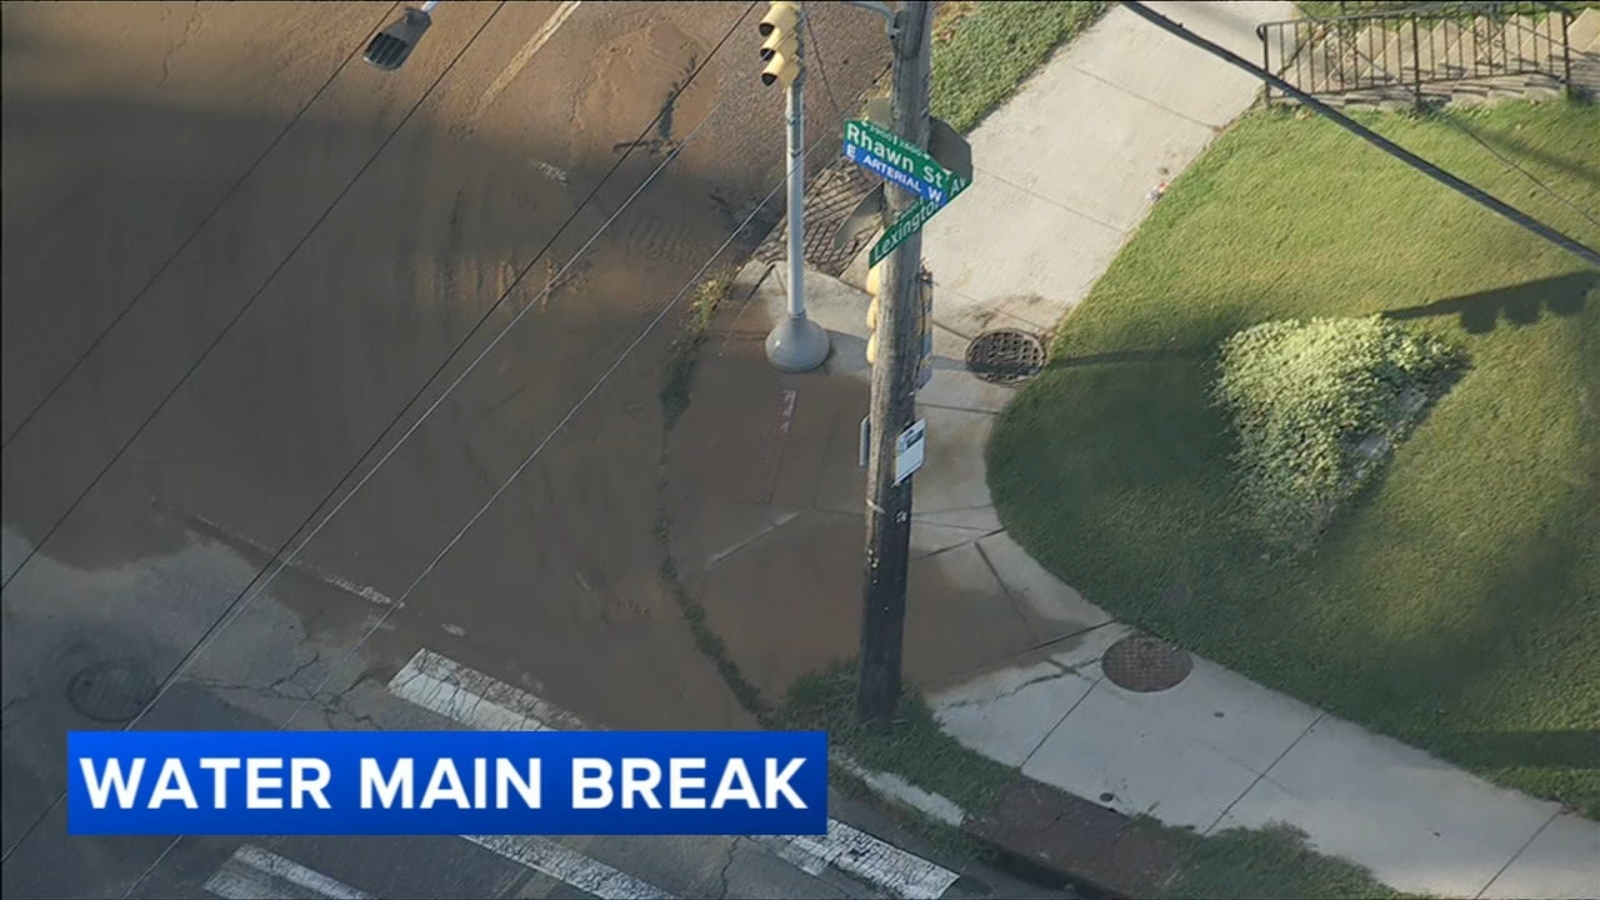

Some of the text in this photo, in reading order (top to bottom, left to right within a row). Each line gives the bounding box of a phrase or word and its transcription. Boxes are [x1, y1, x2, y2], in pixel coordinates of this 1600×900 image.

[846, 123, 914, 173] Rhawn
[923, 165, 943, 188] St
[846, 145, 943, 202] E ARTERIAL W
